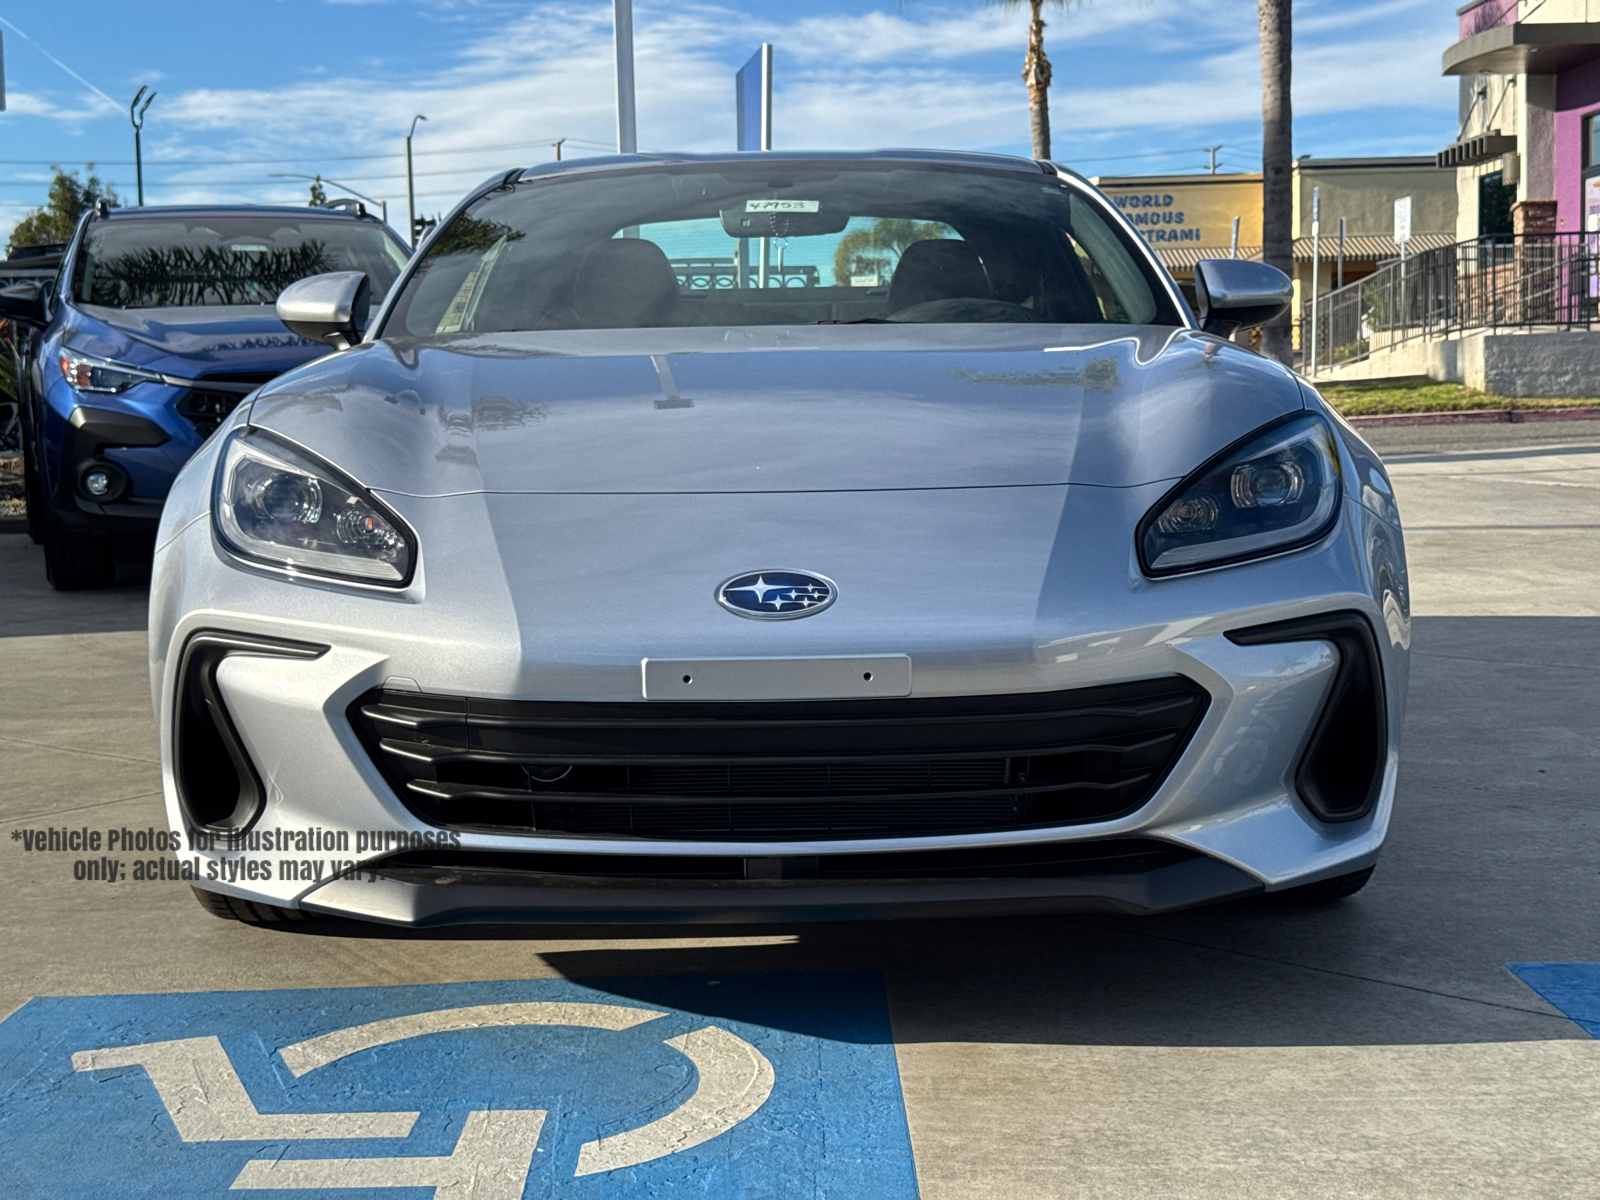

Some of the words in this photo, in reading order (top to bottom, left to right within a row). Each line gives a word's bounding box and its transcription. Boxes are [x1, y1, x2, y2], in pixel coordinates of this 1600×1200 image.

[1113, 195, 1174, 208] WORLD
[1125, 211, 1185, 226] AMOUS
[1140, 228, 1201, 242] TRAMI
